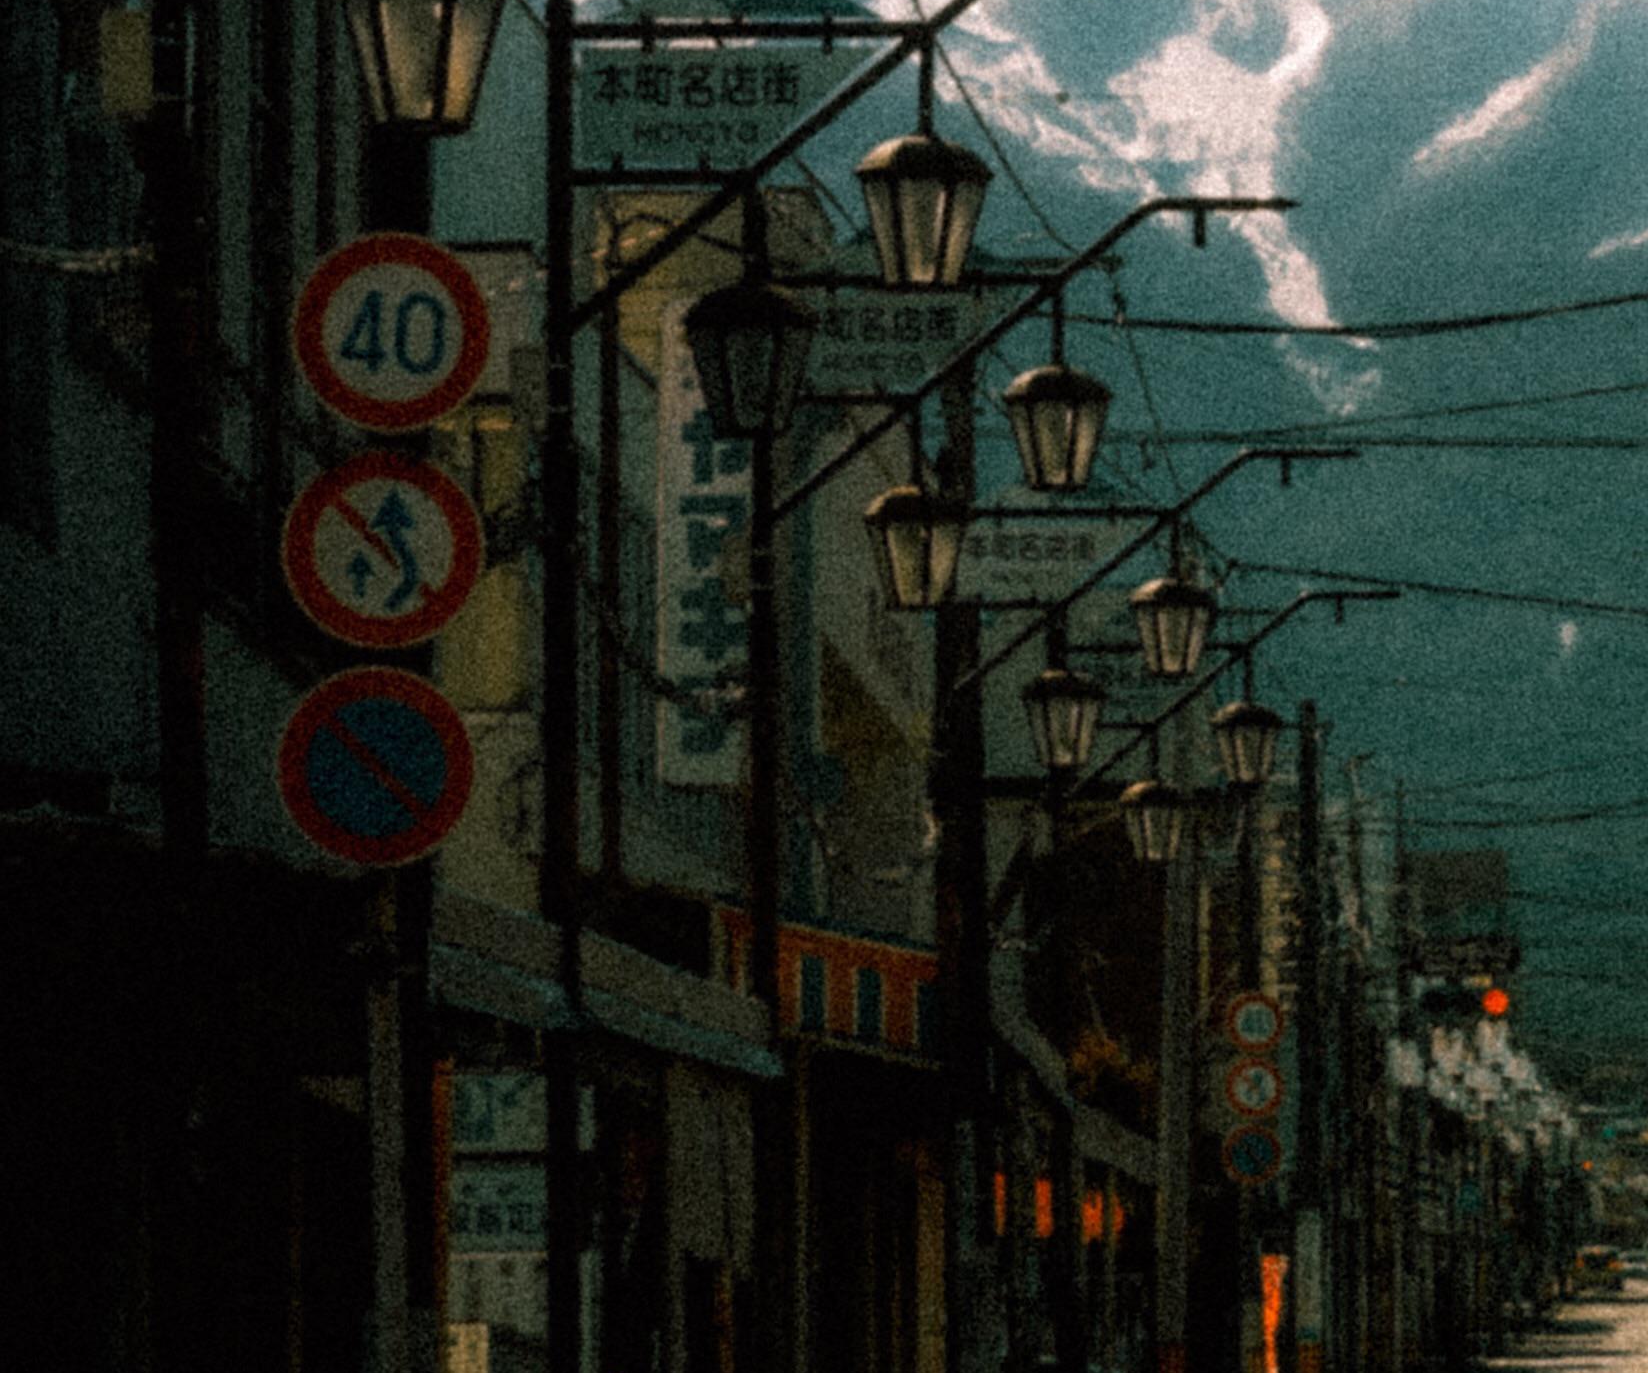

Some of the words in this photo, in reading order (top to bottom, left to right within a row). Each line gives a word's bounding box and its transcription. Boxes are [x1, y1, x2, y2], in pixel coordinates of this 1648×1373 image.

[593, 63, 801, 108] 本町名店街
[340, 290, 446, 375] 40
